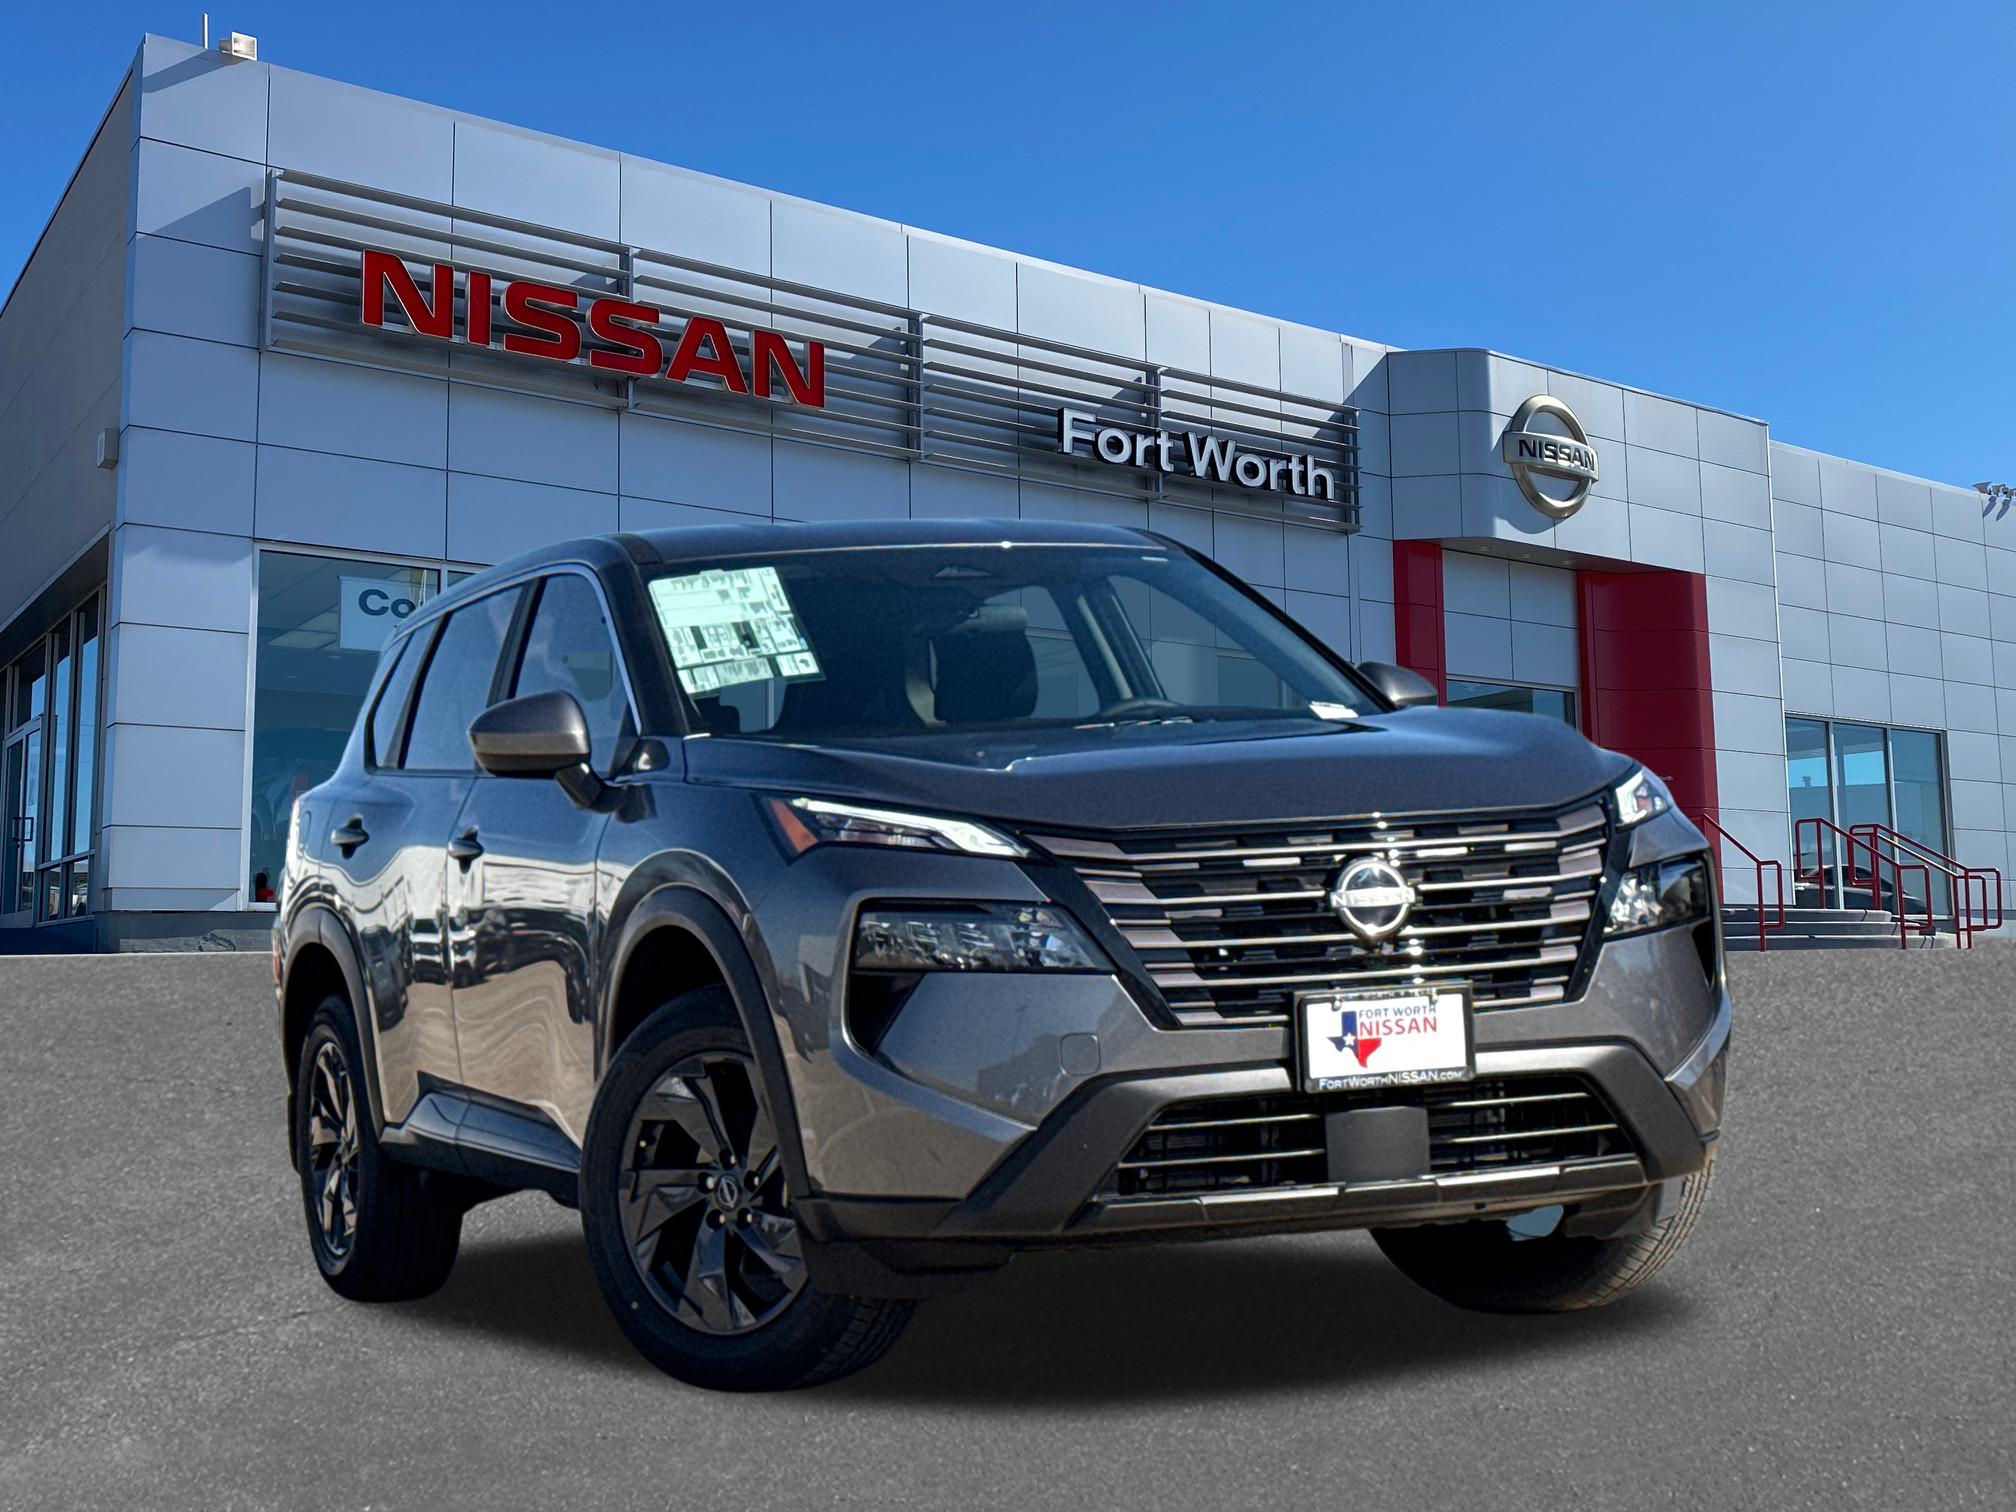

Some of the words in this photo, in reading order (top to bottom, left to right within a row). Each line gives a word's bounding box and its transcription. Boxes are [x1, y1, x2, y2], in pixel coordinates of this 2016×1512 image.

[360, 248, 827, 409] NISSAN
[1057, 406, 1175, 473] Fort
[1182, 430, 1335, 500] Worth
[1517, 439, 1596, 472] NISSAN
[358, 588, 424, 619] Co
[1358, 1008, 1389, 1020] FORT
[1393, 1004, 1437, 1018] WORTH
[1359, 1016, 1438, 1038] NISSAN
